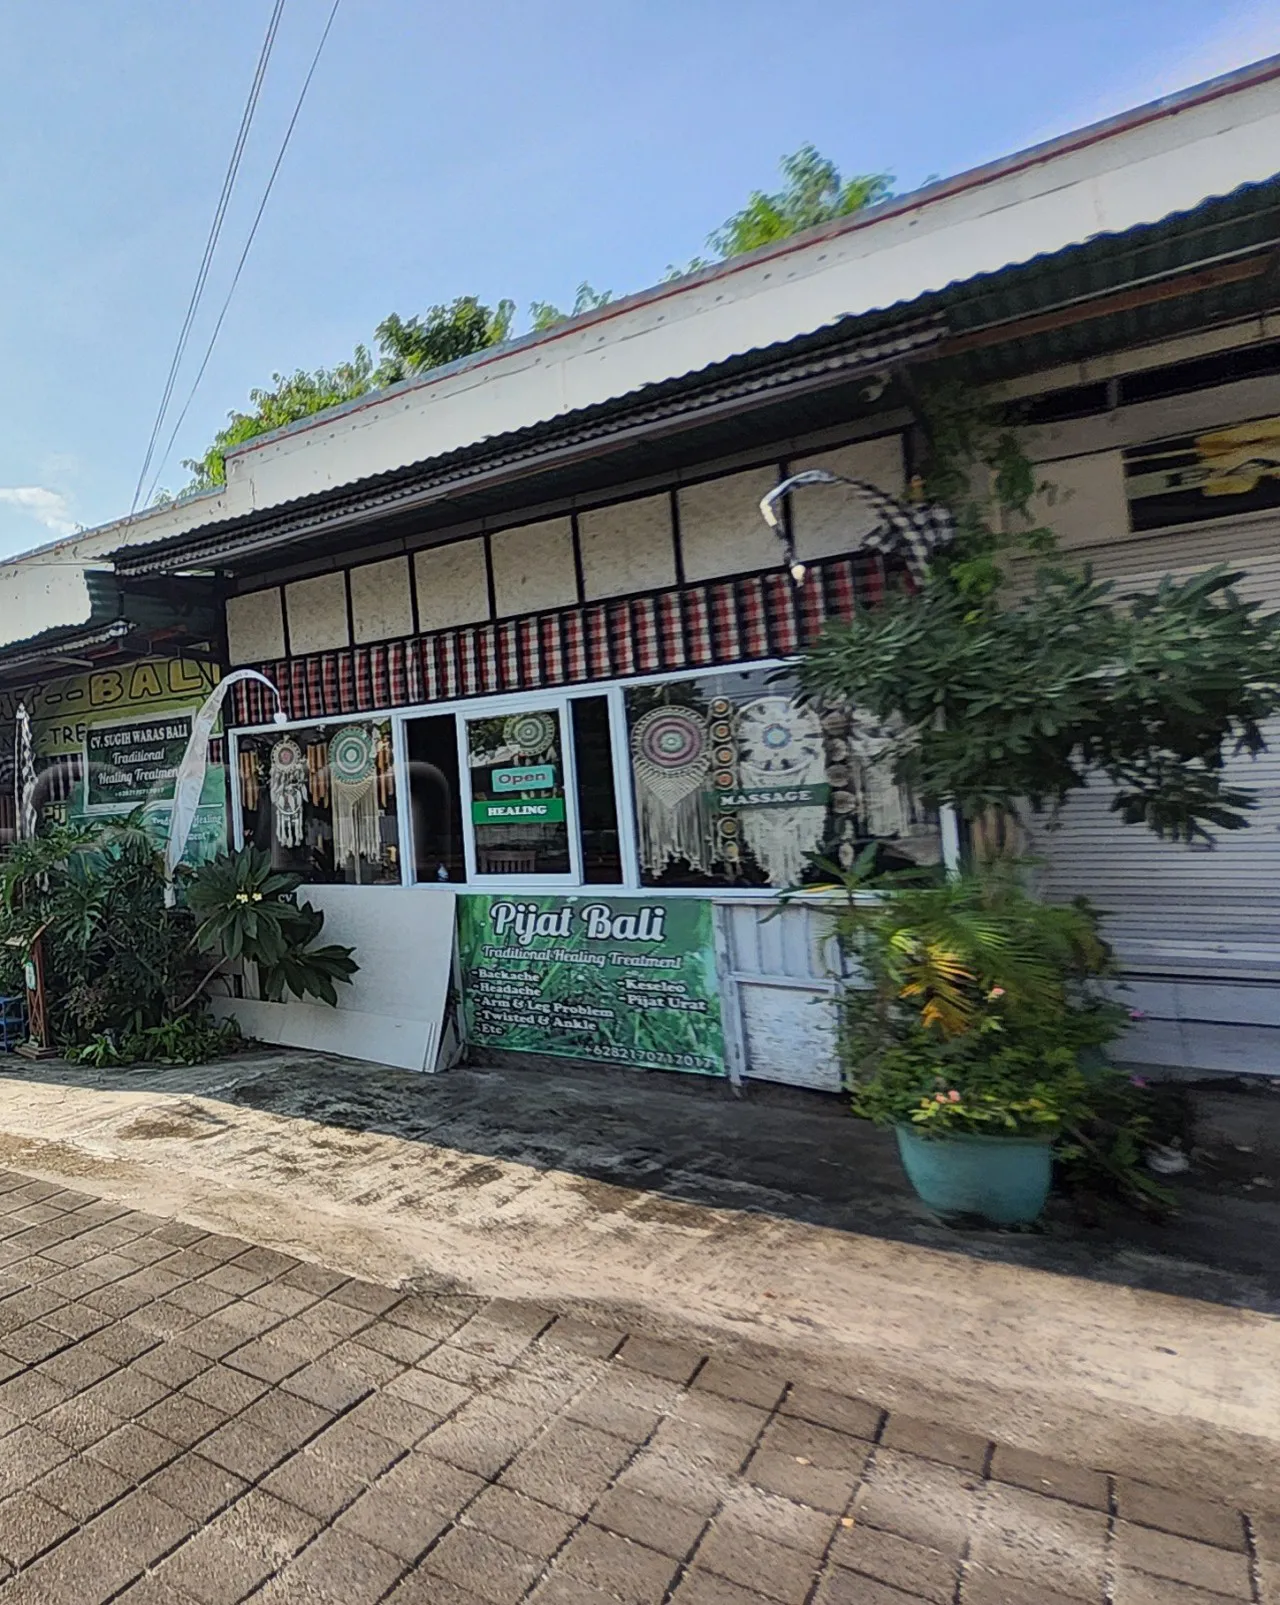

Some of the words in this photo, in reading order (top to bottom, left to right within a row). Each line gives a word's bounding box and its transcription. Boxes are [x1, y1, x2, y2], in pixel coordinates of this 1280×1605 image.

[89, 657, 220, 706] BALI
[104, 732, 132, 747] SUGIH
[132, 727, 165, 743] WARAS
[166, 724, 188, 739] BALI
[112, 747, 165, 765] Traditional
[98, 771, 133, 786] Healing
[134, 768, 181, 781] Treatmen
[498, 773, 547, 785] Open
[720, 790, 813, 806] MASSAGE
[487, 805, 548, 817] HEALING
[489, 902, 573, 946] Pijat
[581, 904, 665, 942] Bali
[482, 945, 552, 961] Traditional
[553, 949, 607, 969] Healing
[608, 951, 683, 970] Treatment
[512, 998, 524, 1009] &
[527, 1000, 551, 1014] Leg
[553, 1002, 614, 1017] Problem
[667, 997, 708, 1012] Urat
[538, 1014, 550, 1025] &
[552, 1017, 598, 1031] Ankle
